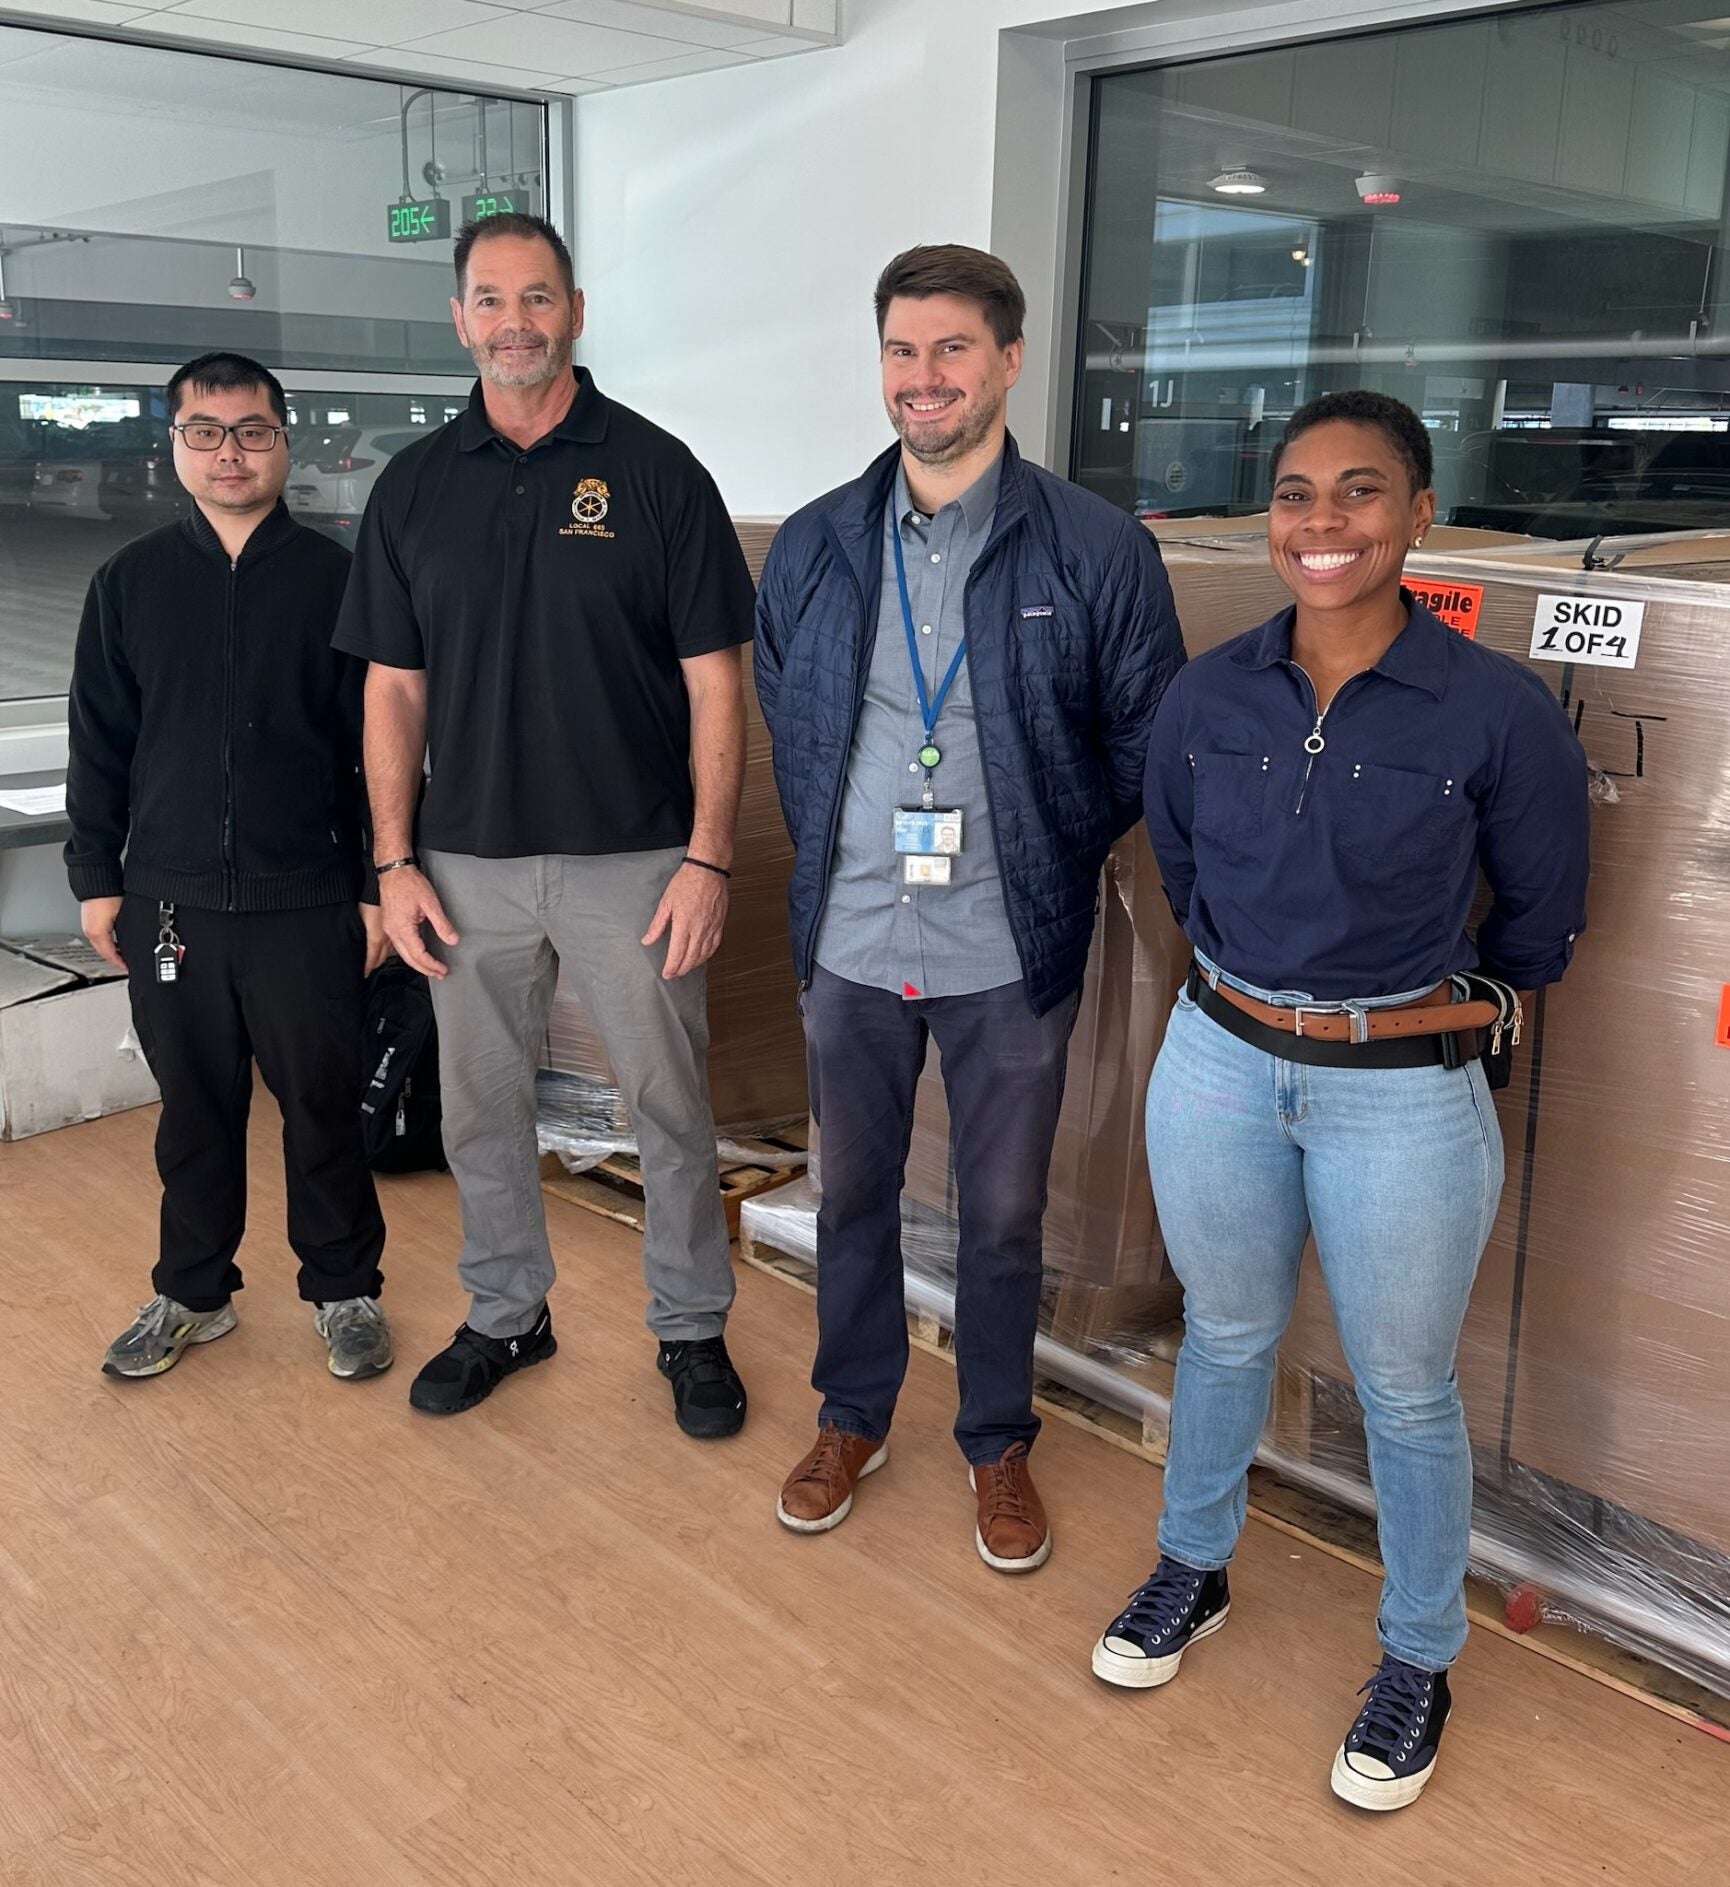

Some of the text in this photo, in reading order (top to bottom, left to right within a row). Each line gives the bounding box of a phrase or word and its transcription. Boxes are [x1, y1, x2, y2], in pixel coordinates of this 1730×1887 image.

[391, 206, 420, 237] 205
[1149, 379, 1174, 408] 1J
[558, 528, 615, 538] SAN FRANCISCO
[1553, 601, 1623, 627] SKID
[1537, 626, 1627, 657] 1 OF 4
